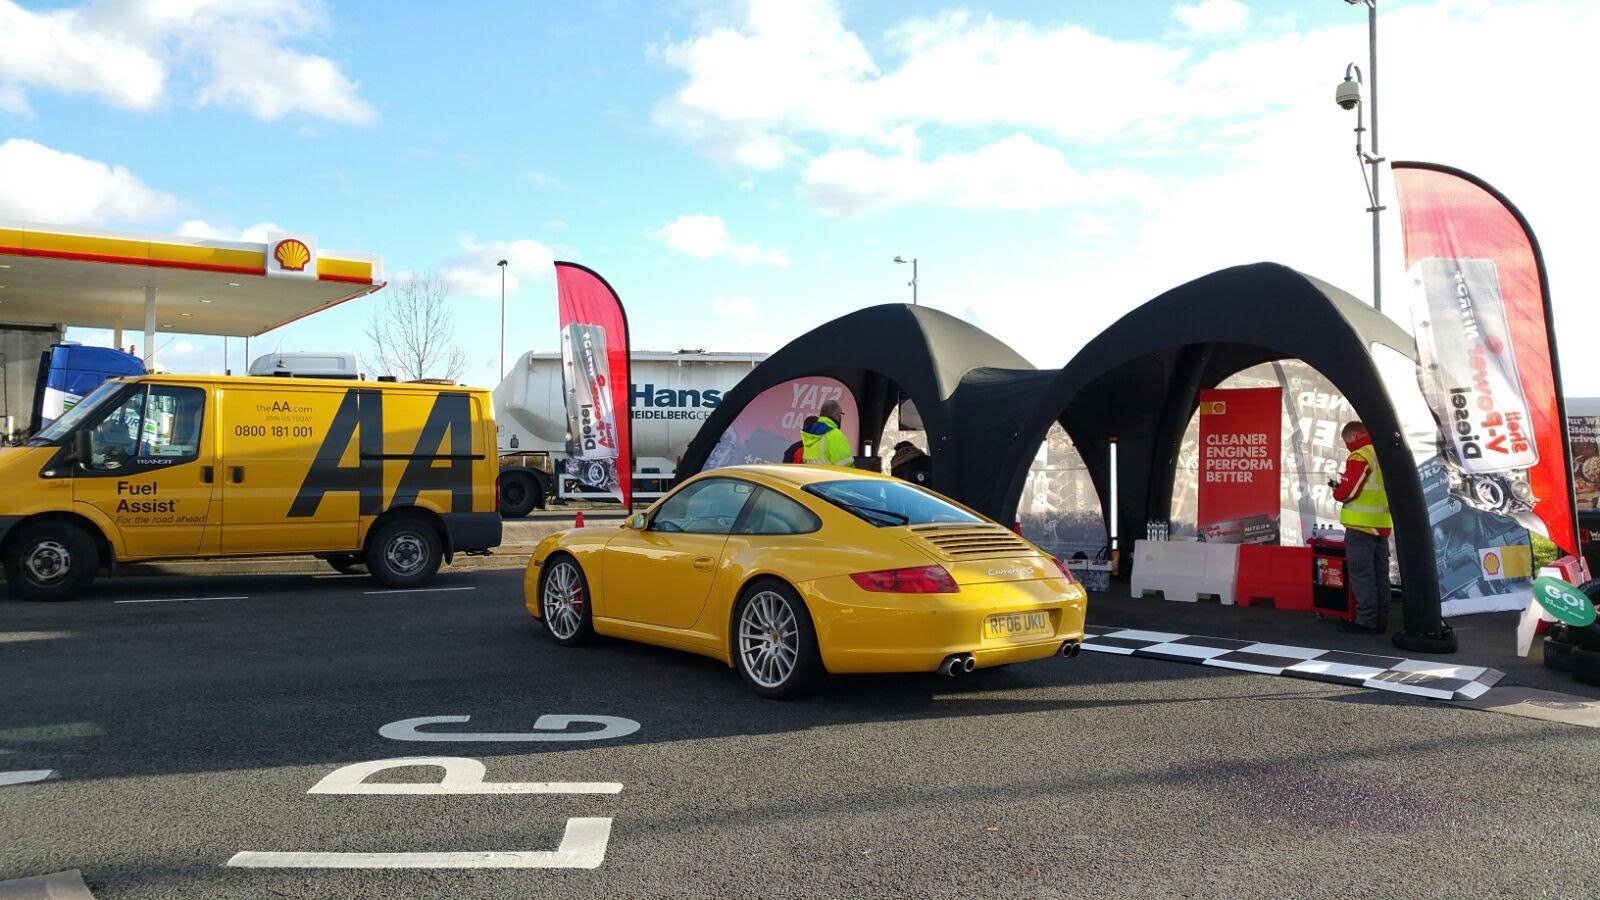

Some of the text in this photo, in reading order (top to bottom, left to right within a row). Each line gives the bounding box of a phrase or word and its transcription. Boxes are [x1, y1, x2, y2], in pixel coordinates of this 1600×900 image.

[631, 383, 727, 408] Hans
[235, 425, 313, 437] 0800 181 001
[1206, 433, 1268, 446] CLEANER
[286, 388, 474, 517] AA
[1206, 446, 1268, 458] ENGINES
[1206, 458, 1274, 470] PERFORM
[1206, 470, 1254, 483] BETTER
[117, 480, 157, 495] Fuel
[116, 498, 176, 513] Assist
[116, 514, 206, 525] For the road ahead
[1544, 584, 1585, 611] GO!
[990, 613, 1046, 634] RF06 UKU
